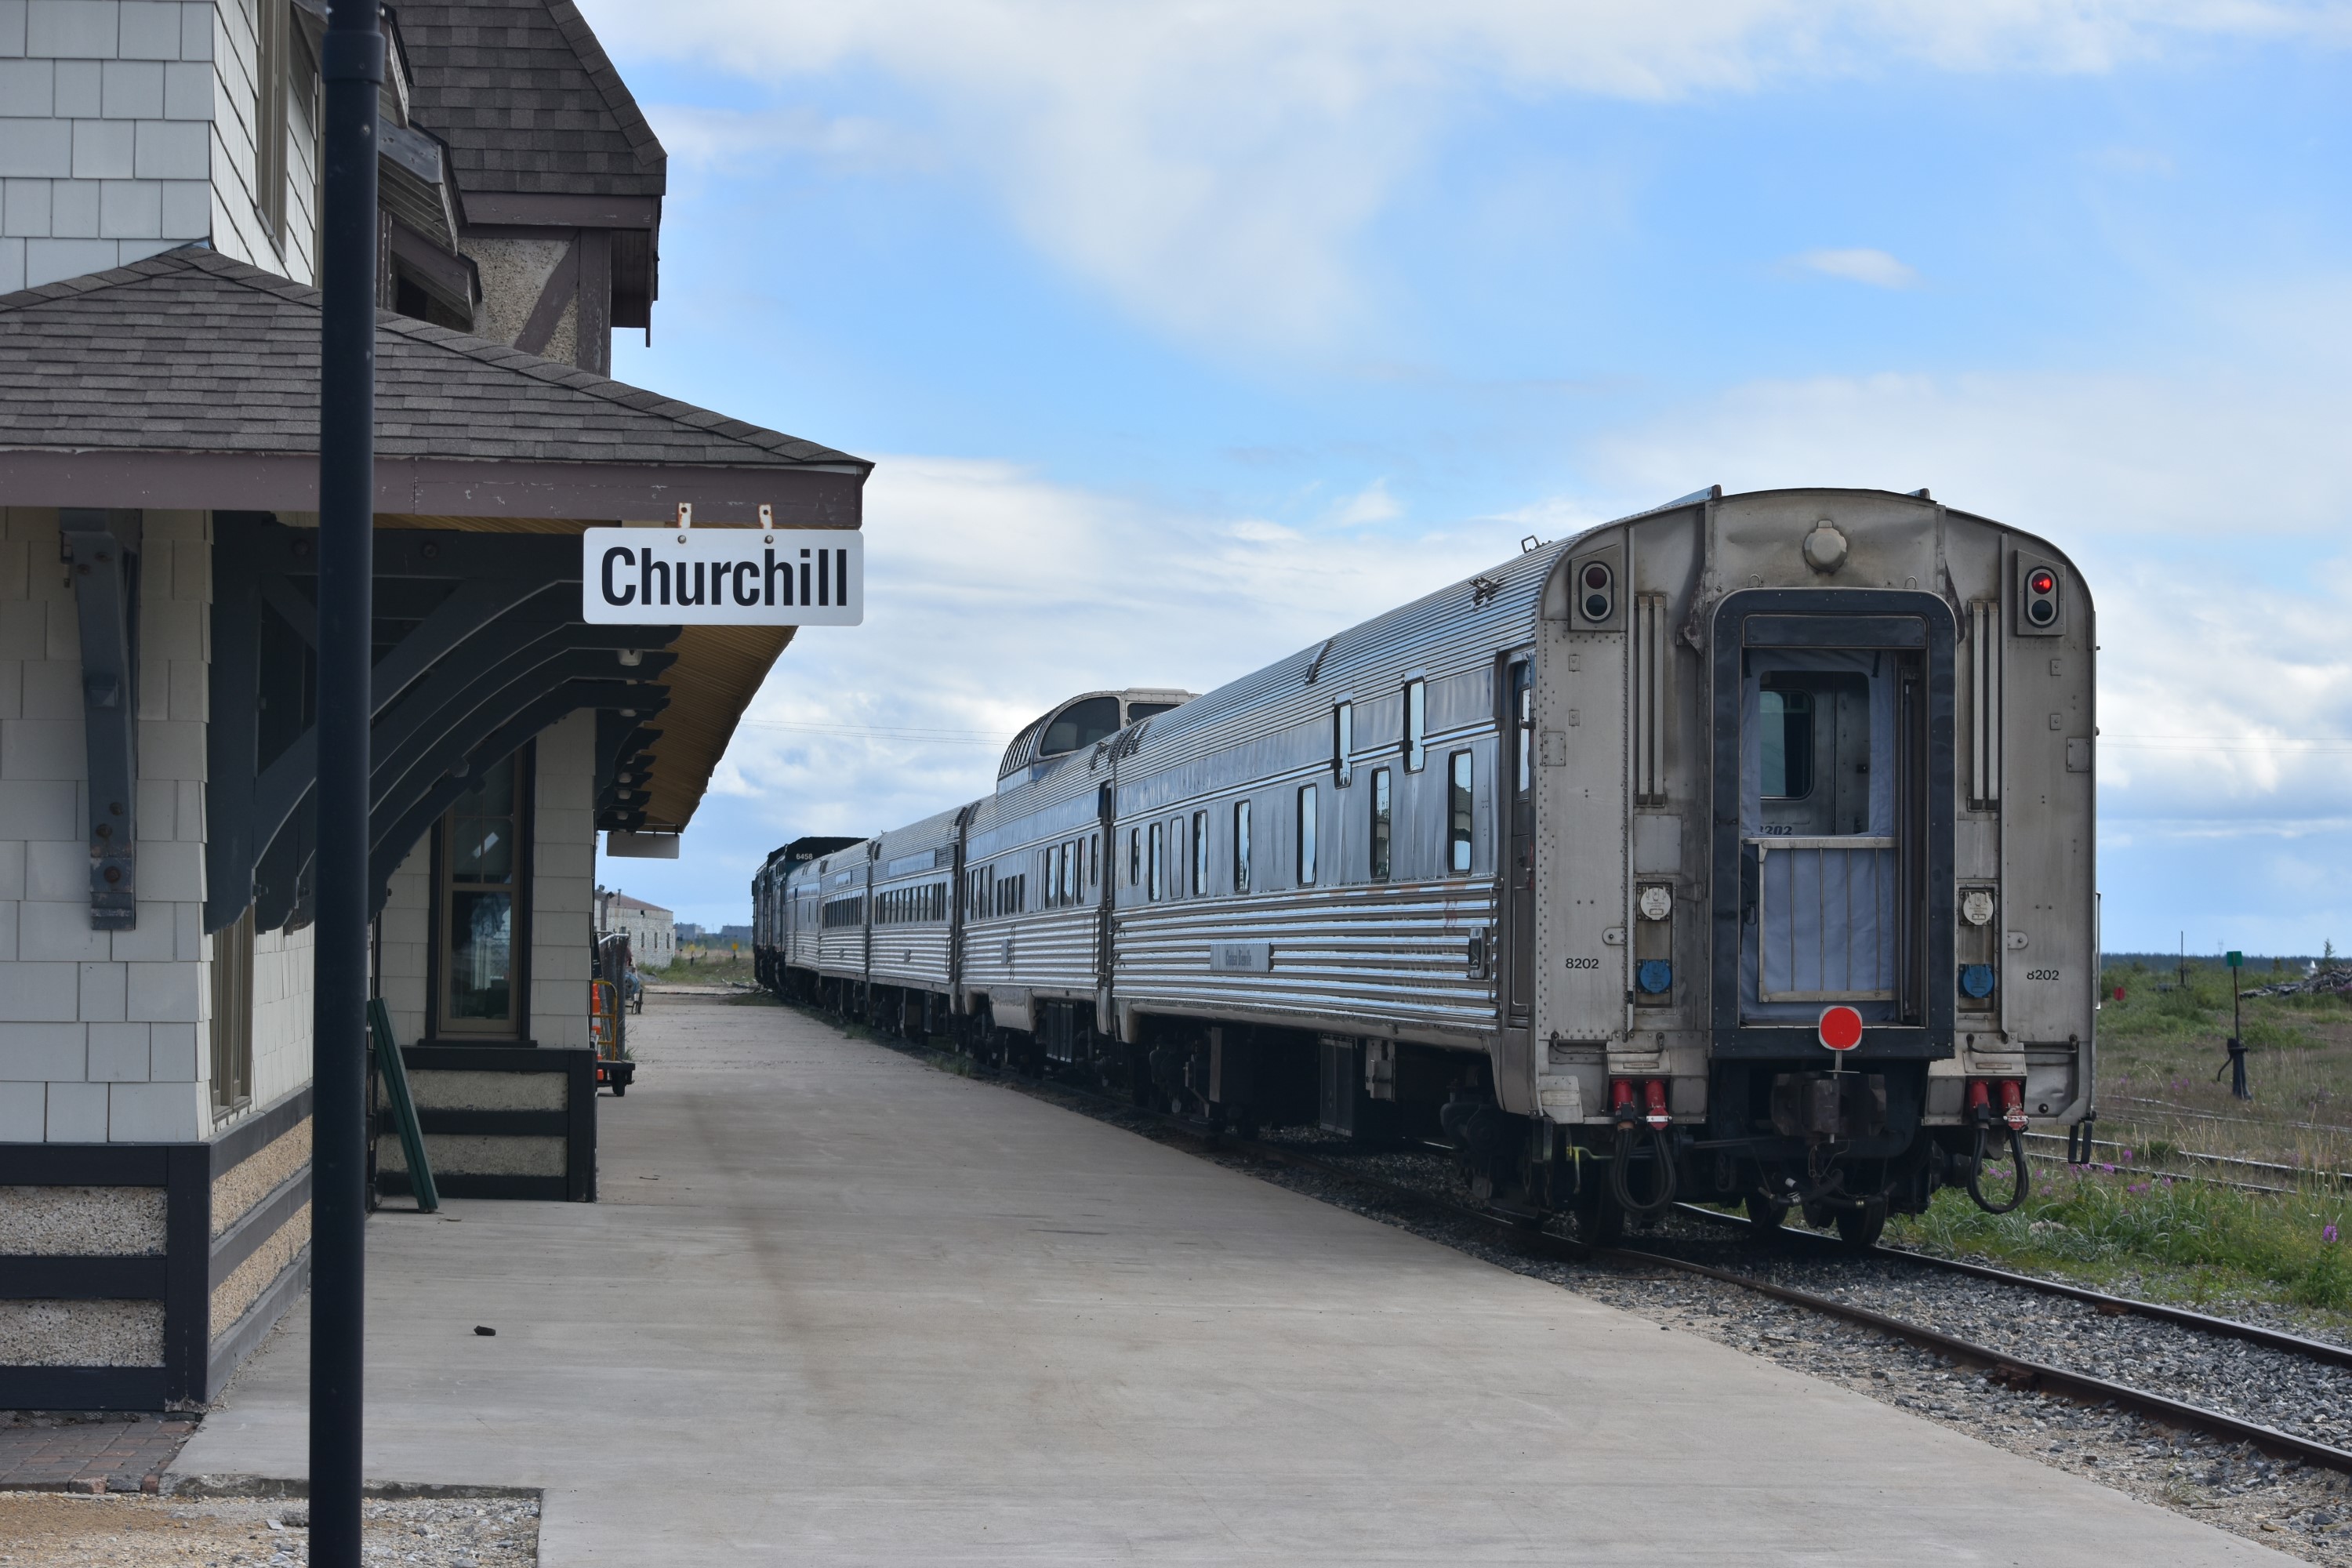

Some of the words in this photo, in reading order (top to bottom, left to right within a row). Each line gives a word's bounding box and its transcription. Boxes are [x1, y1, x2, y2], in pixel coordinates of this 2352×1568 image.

[601, 546, 848, 607] Churchill
[1566, 958, 1599, 969] 8202
[2027, 969, 2060, 980] 8202
